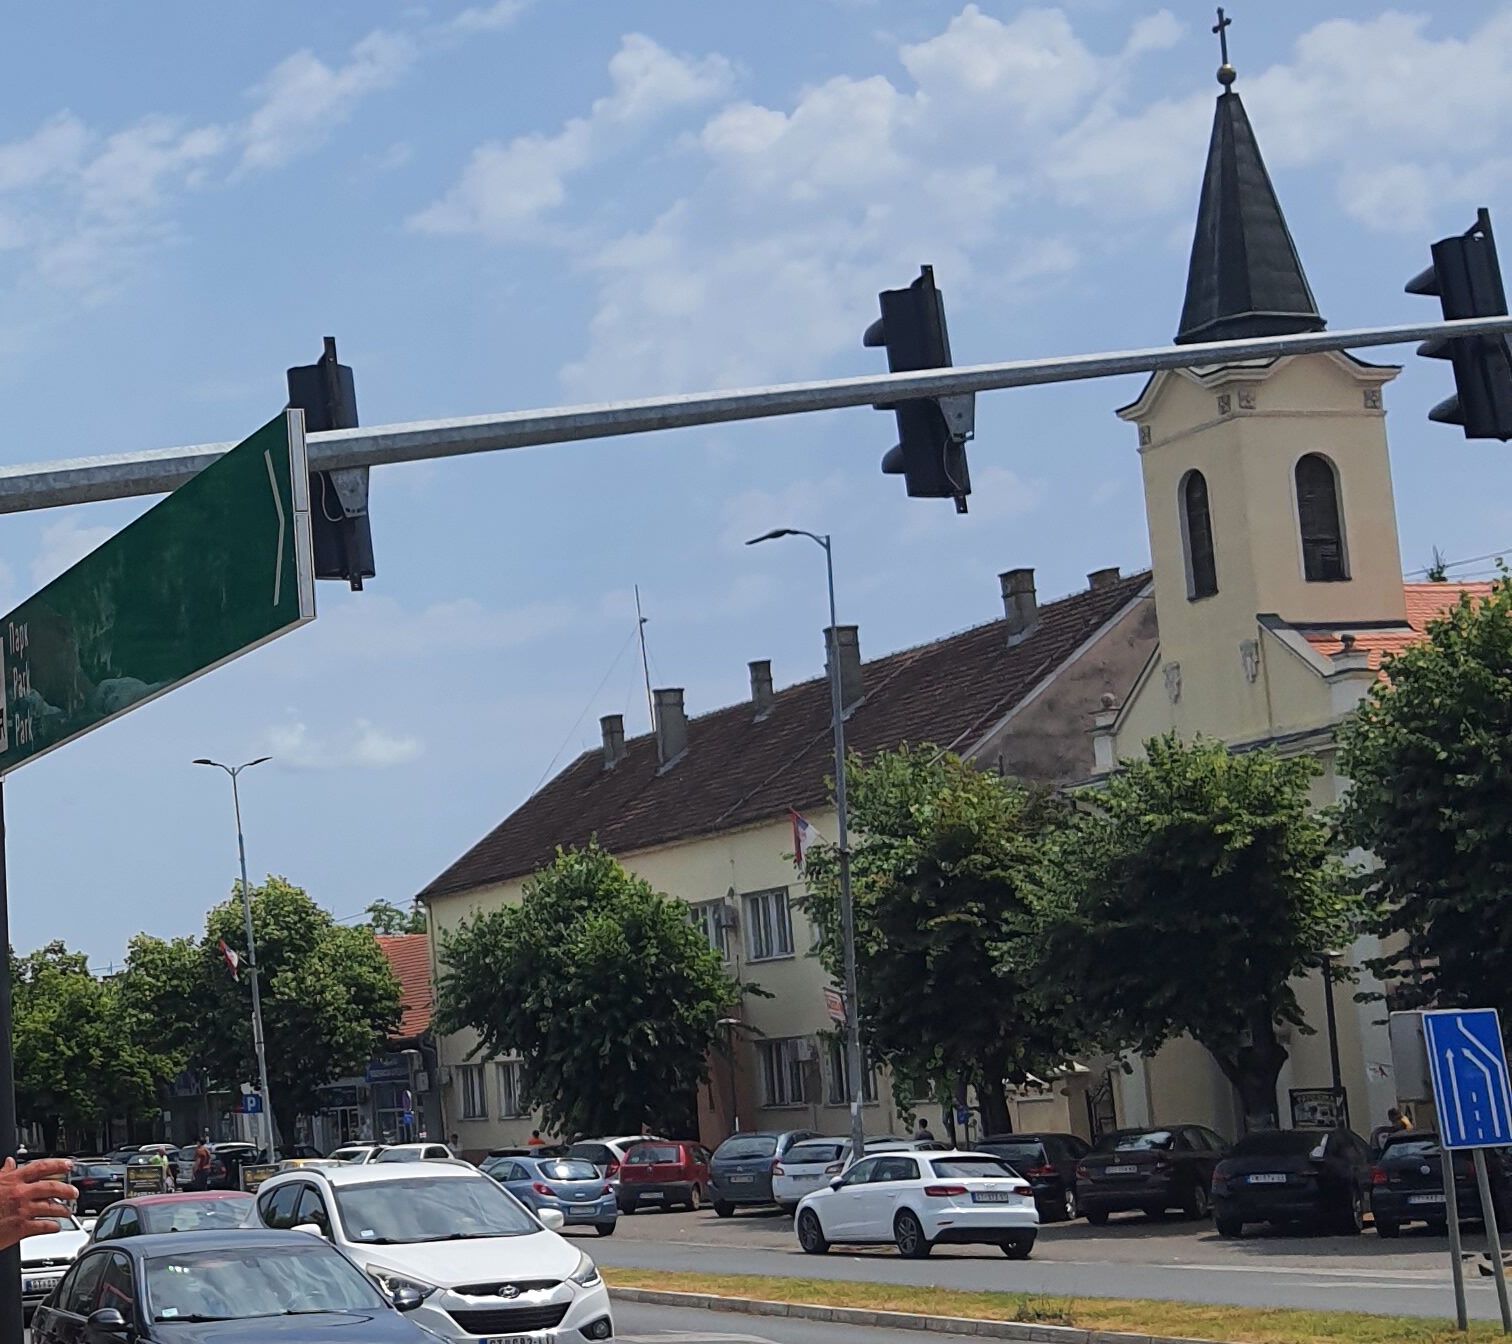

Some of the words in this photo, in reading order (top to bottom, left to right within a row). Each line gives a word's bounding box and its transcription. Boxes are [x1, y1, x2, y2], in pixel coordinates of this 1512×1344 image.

[8, 621, 29, 660] Парк
[12, 660, 31, 702] Park
[15, 708, 34, 748] Park
[246, 1096, 257, 1112] P
